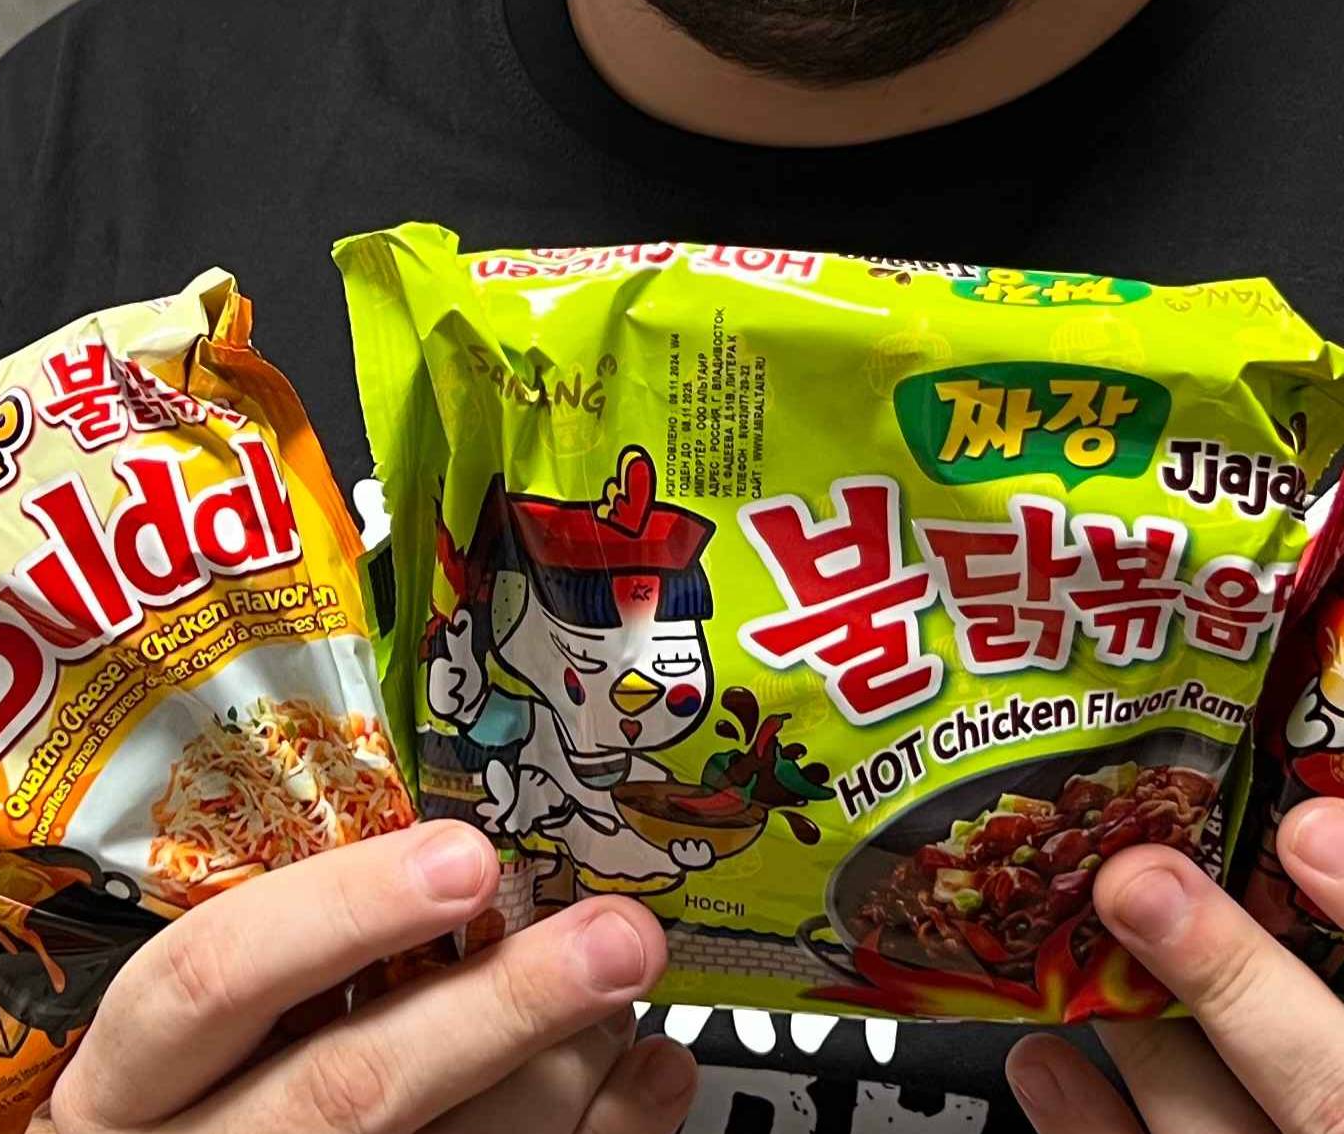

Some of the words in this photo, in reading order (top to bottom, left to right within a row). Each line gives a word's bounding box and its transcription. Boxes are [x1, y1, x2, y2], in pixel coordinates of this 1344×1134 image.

[934, 379, 1140, 469] 짜장
[680, 461, 691, 497] ГОДЕН
[5, 728, 70, 819] Quattro
[60, 661, 127, 733] Cheese
[141, 600, 230, 661] Chicken
[228, 584, 309, 615] Flavor
[837, 729, 925, 818] HOT
[932, 696, 1077, 761] Chicken
[1086, 689, 1178, 726] Flavor
[30, 777, 71, 847] Nouilles
[684, 893, 746, 917] HOCHI
